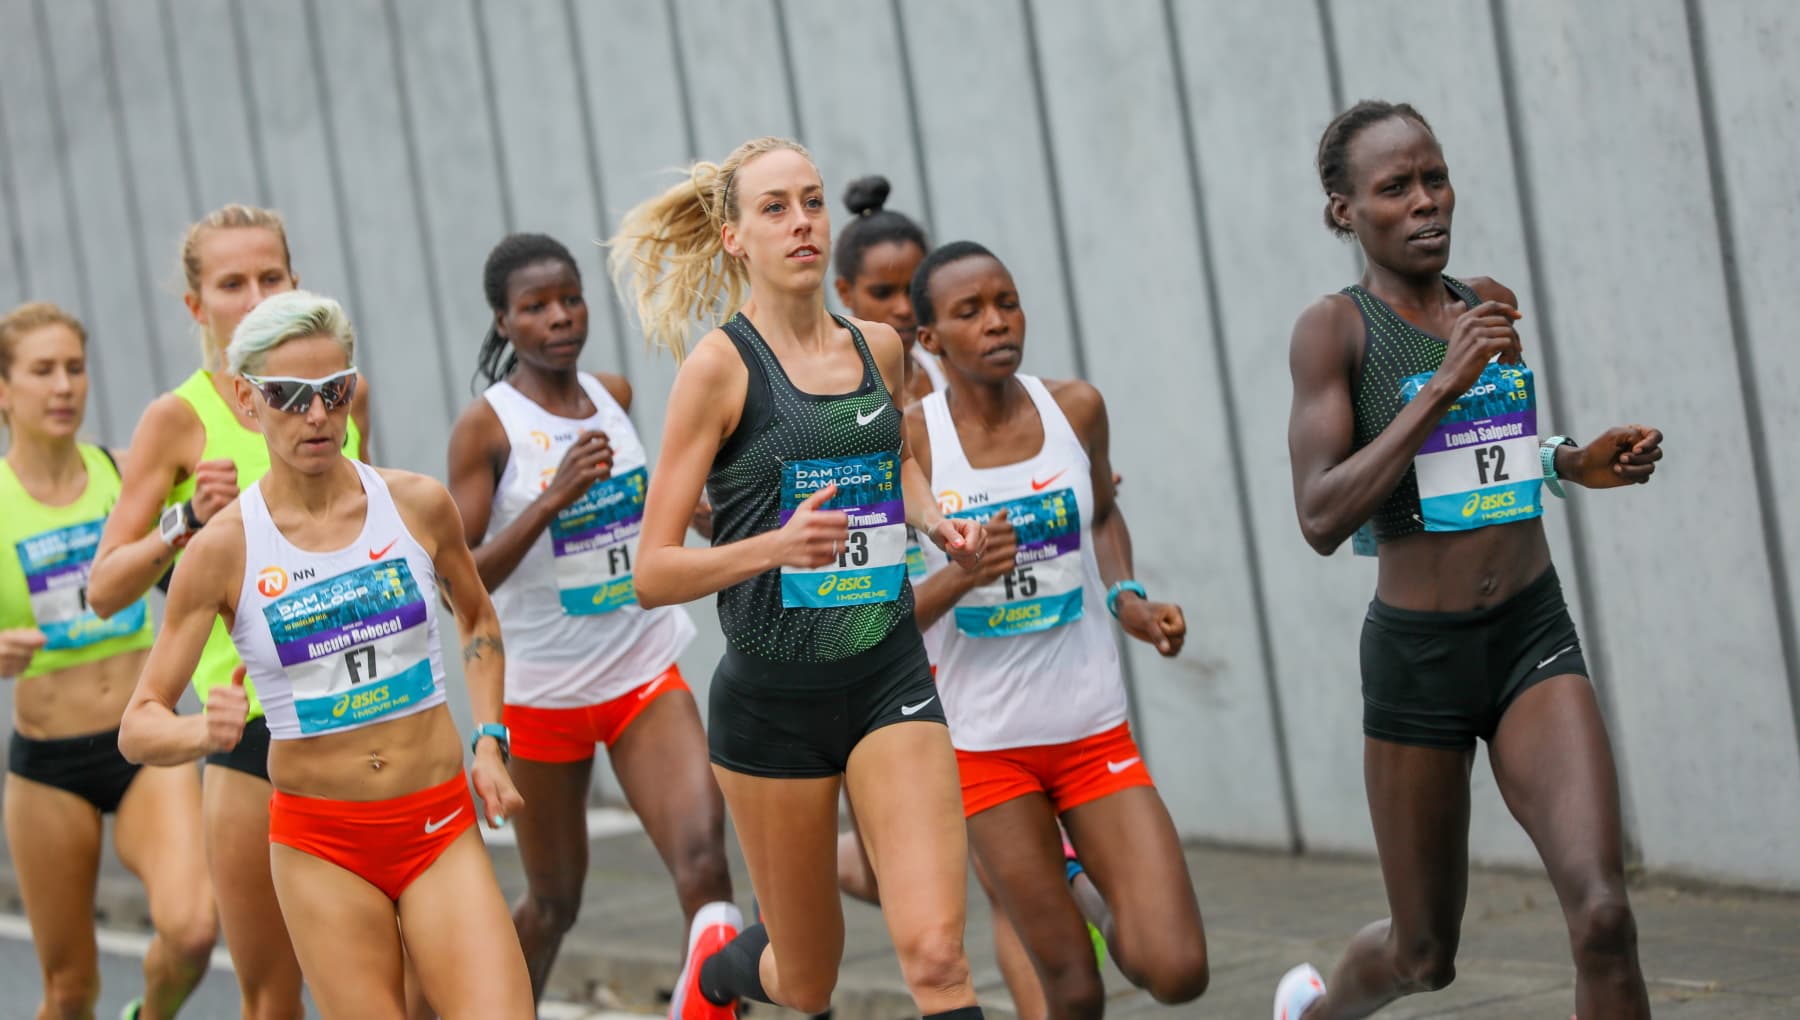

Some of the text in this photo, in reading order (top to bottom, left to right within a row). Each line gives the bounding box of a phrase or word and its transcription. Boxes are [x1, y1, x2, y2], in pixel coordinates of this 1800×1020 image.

[1445, 422, 1523, 448] Lonah Salpeter
[796, 464, 862, 479] DAM TOT
[878, 460, 894, 471] 23
[885, 471, 893, 480] 9
[1474, 445, 1509, 485] F2
[795, 475, 872, 489] DAMLOOP
[968, 492, 989, 504] NN
[1481, 491, 1516, 511] asics
[608, 544, 631, 576] F1
[293, 568, 316, 581] NN
[837, 575, 872, 592] asics
[1004, 566, 1037, 601] F5
[279, 592, 318, 616] DAM
[308, 634, 350, 660] Ancuta
[344, 645, 377, 685] F7
[351, 686, 390, 710] asics
